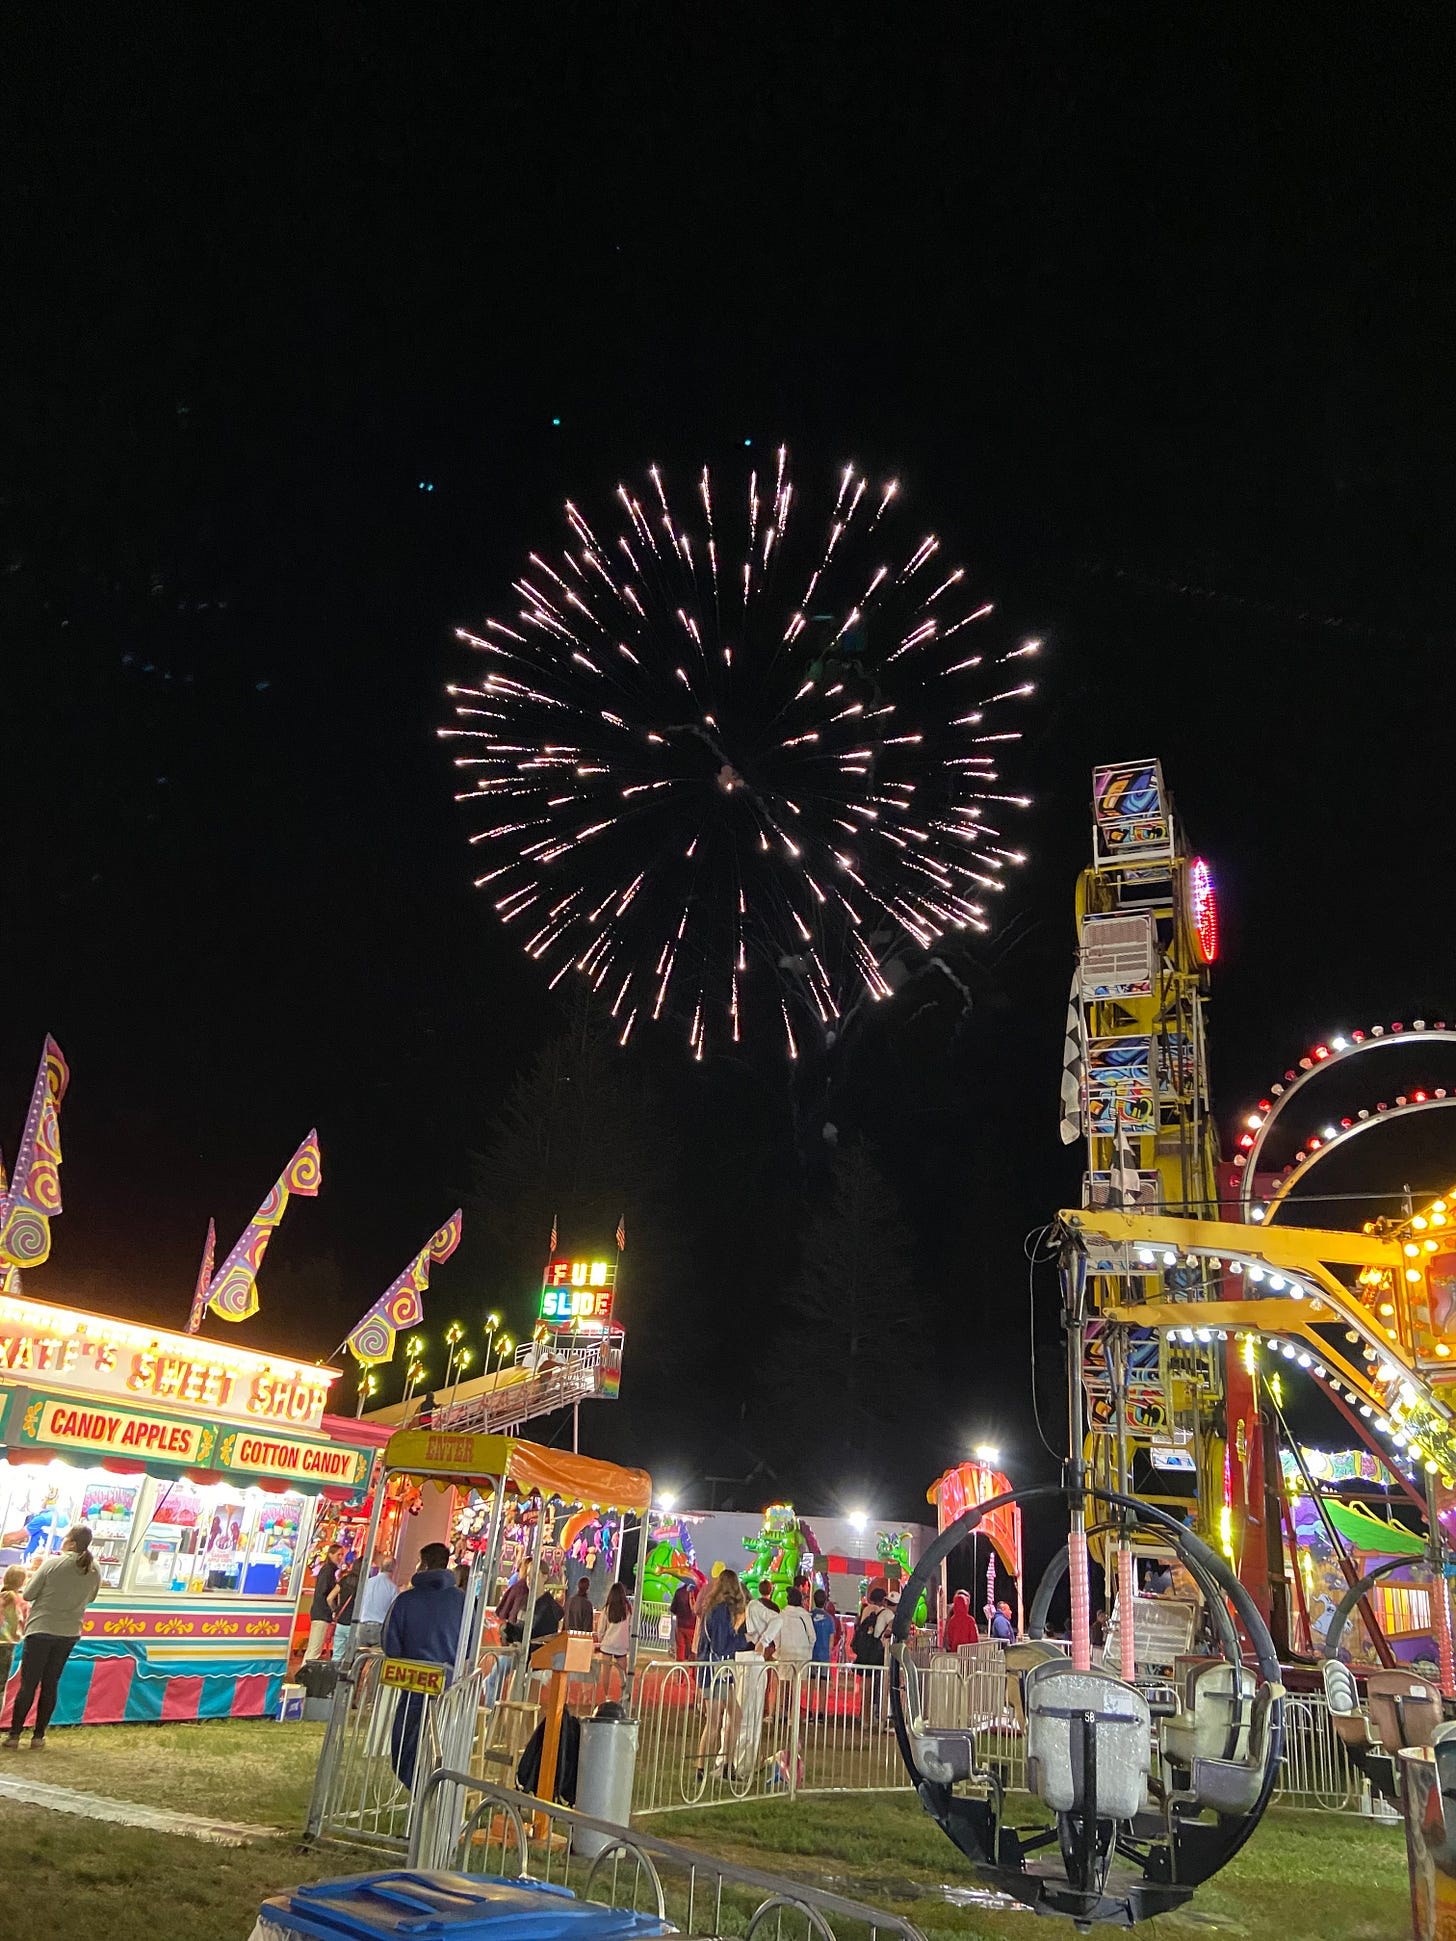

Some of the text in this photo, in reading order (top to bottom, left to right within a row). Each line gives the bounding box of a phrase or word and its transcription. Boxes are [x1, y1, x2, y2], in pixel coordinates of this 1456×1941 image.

[553, 1262, 607, 1287] FUN
[543, 1291, 610, 1316] SLIDE
[127, 1353, 241, 1407] SWEET
[246, 1371, 328, 1422] SHOP
[50, 1408, 193, 1453] CANDY APPLES
[240, 1439, 351, 1476] COTTON CANDY
[425, 1435, 474, 1462] ENTER
[384, 1664, 439, 1689] ENTER
